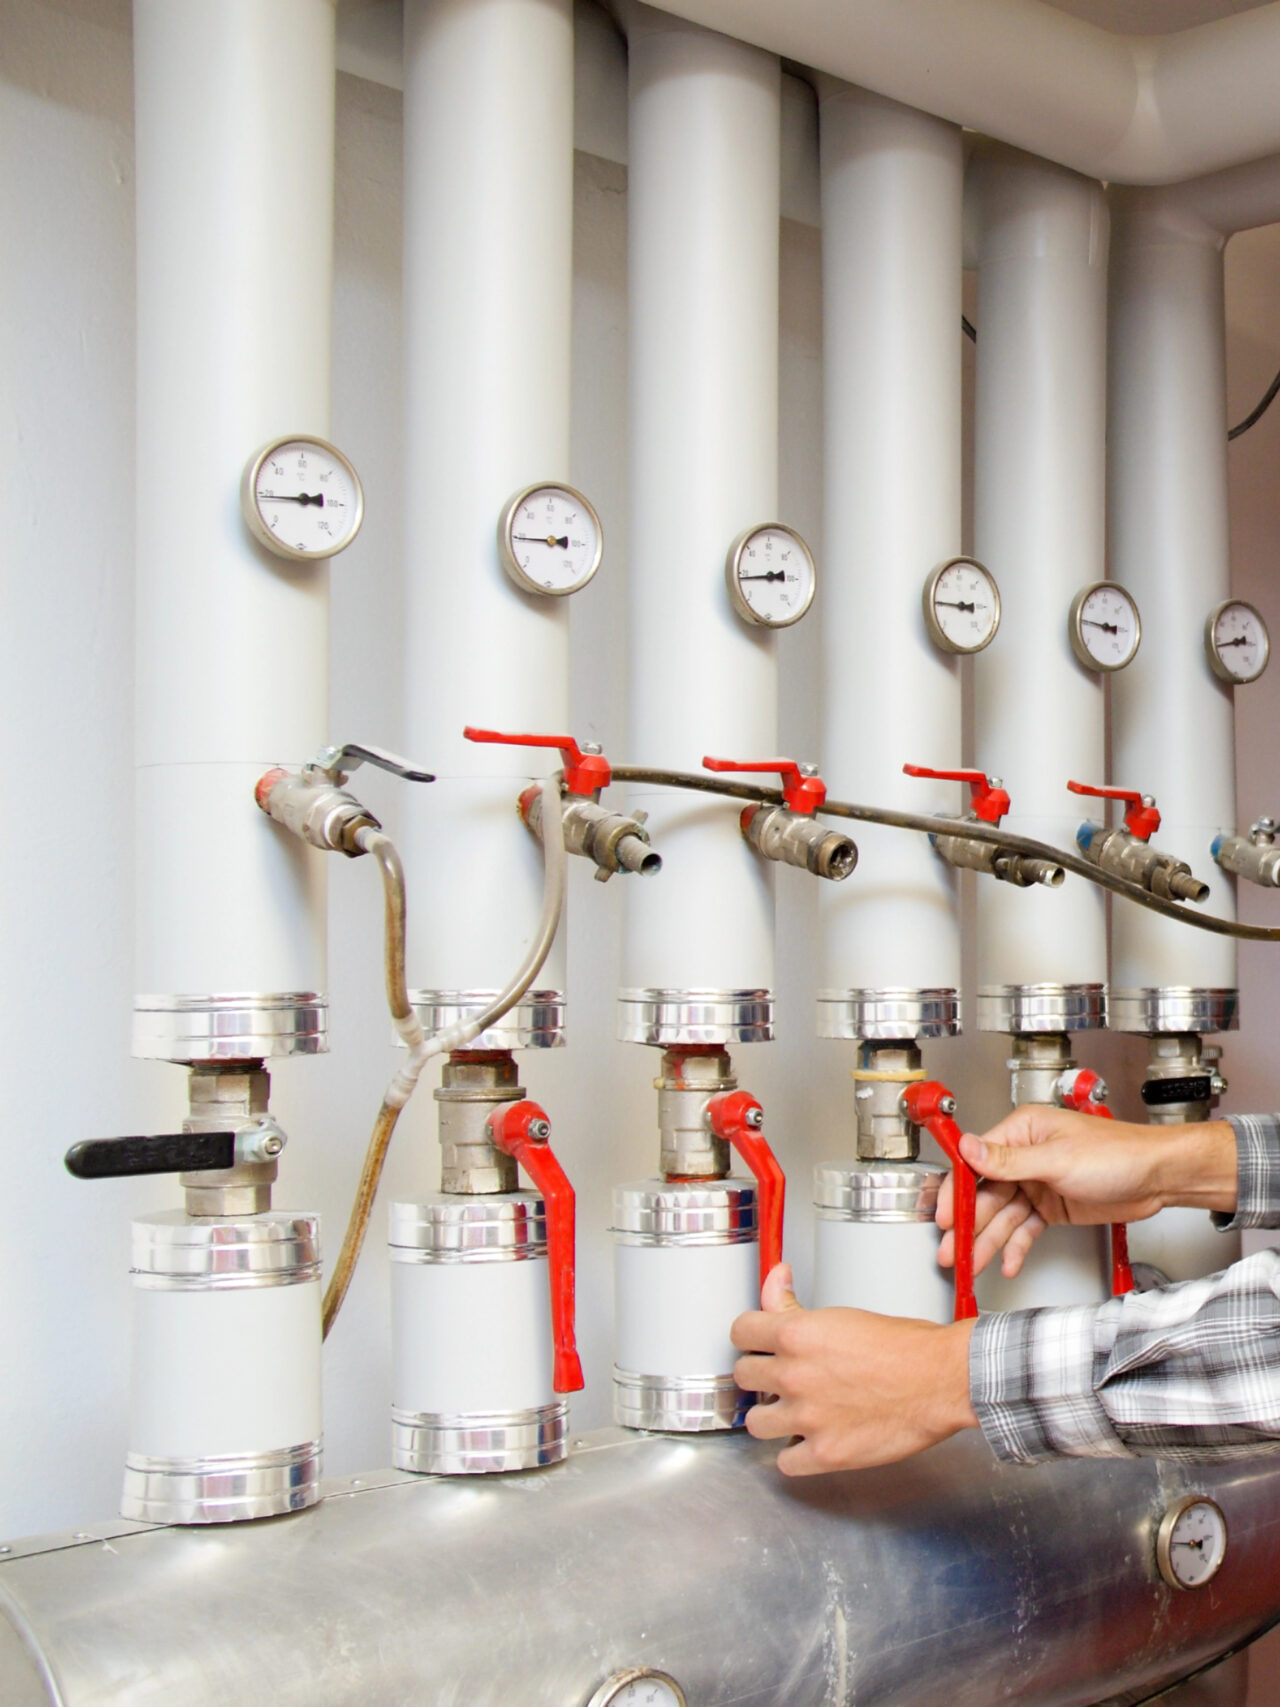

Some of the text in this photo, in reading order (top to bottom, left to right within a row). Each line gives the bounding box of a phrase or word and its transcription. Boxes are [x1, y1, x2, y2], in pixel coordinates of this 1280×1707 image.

[297, 460, 307, 468] 60
[274, 467, 284, 476] 40
[319, 473, 328, 482] 80
[264, 489, 274, 497] 20
[317, 520, 329, 530] 120
